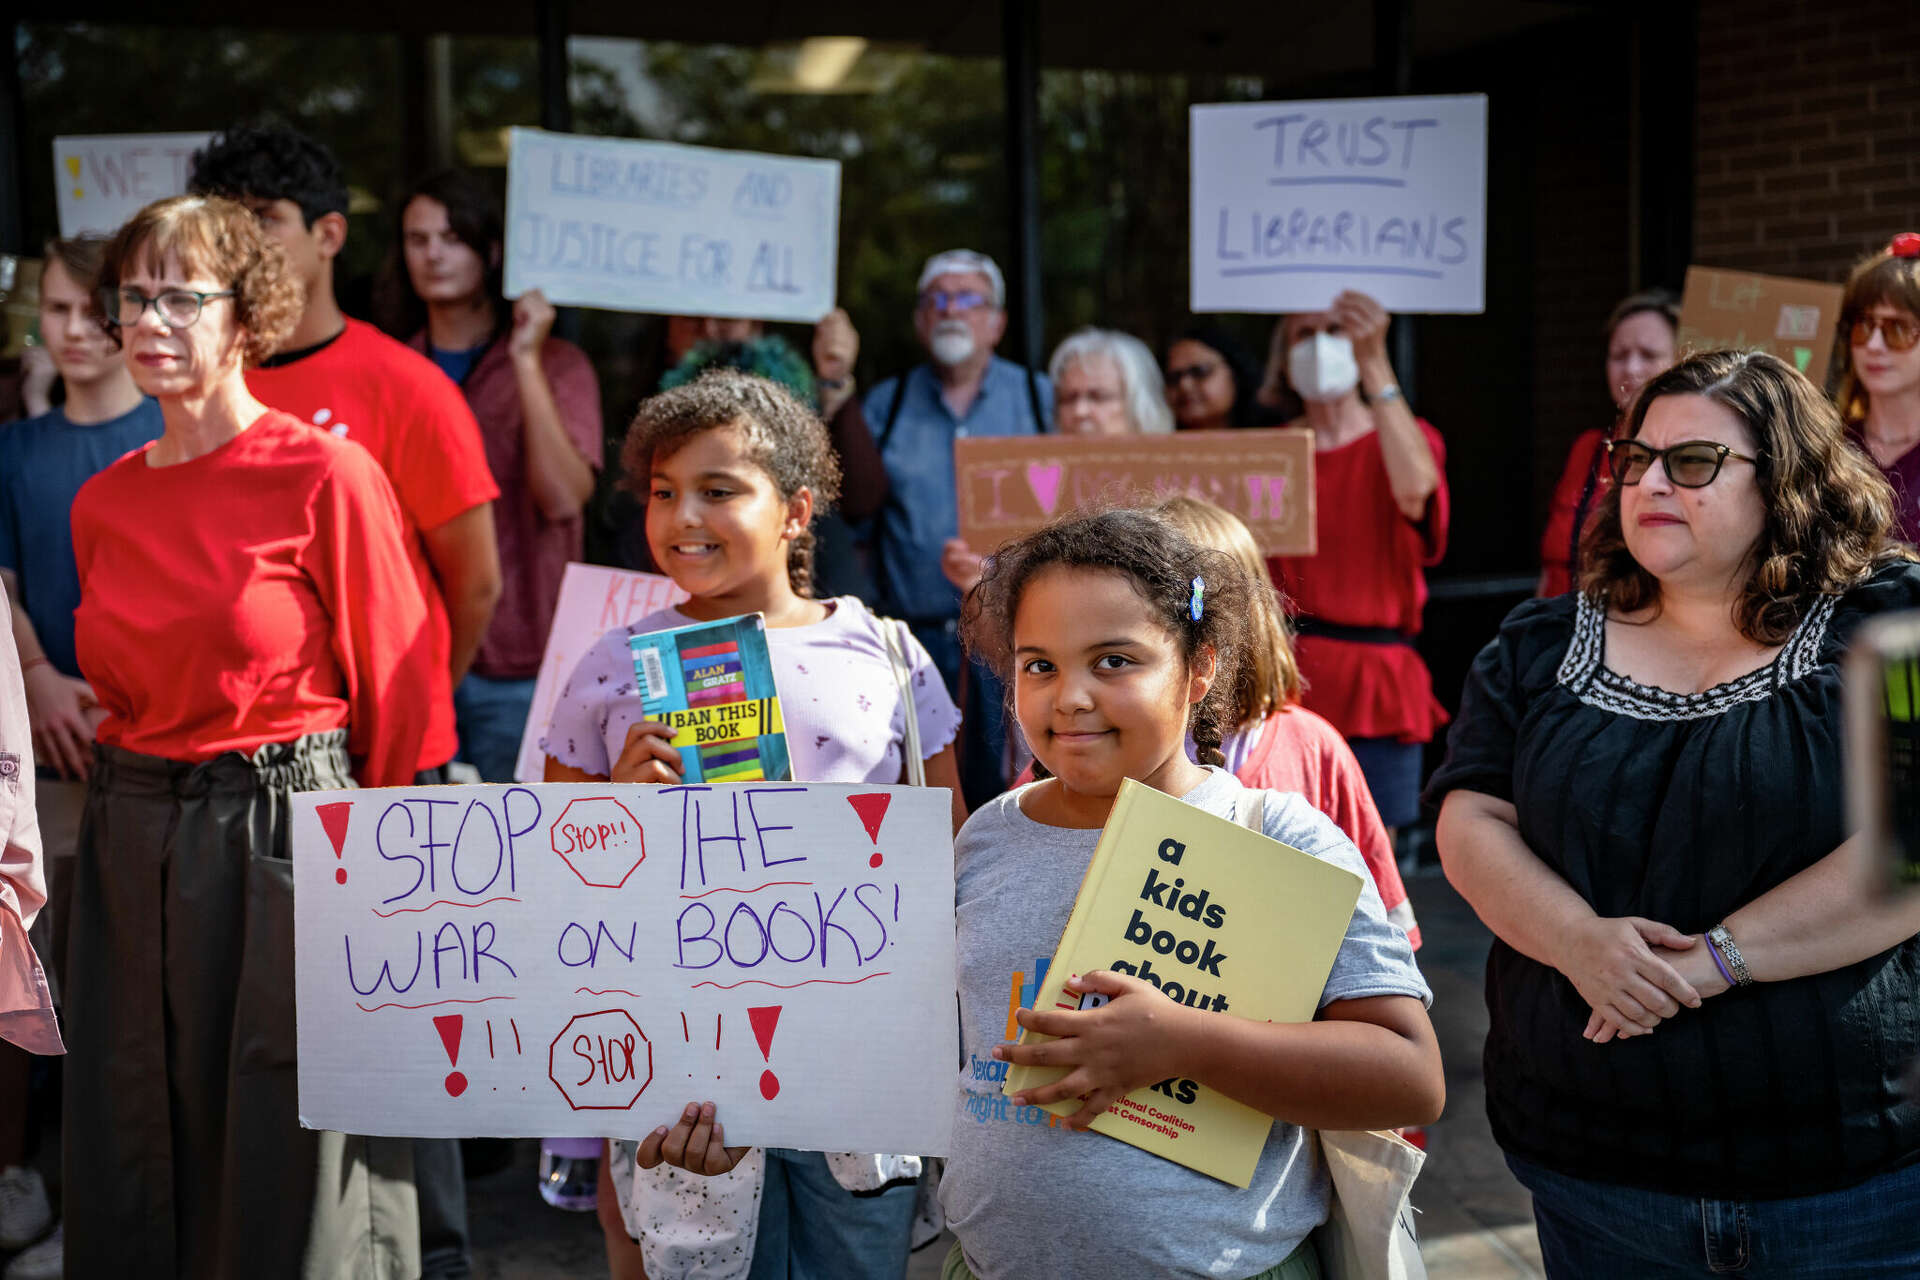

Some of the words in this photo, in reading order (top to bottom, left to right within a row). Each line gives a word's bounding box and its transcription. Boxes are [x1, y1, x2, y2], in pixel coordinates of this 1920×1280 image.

[1253, 113, 1440, 169] TRUST
[88, 147, 153, 198] WE
[549, 150, 710, 203] LIBRARIES
[732, 170, 793, 209] AND
[514, 212, 661, 278] JUSTICE
[678, 231, 734, 284] FOR
[749, 240, 801, 293] ALL
[1216, 207, 1470, 266] LIBRARIANS
[976, 469, 1012, 520] I
[693, 664, 726, 681] ALAN
[702, 672, 737, 688] GRATZ
[675, 710, 711, 728] BAN
[717, 703, 757, 722] THIS
[695, 722, 741, 743] BOOK
[376, 788, 542, 905] STOP
[657, 786, 808, 890] THE
[1157, 837, 1186, 866] a
[1139, 867, 1227, 929] kids
[344, 921, 518, 996] WAR
[557, 918, 636, 969] ON
[672, 883, 900, 969] BOOKS!
[1123, 909, 1228, 978] book
[1016, 1104, 1043, 1126] to
[1120, 1109, 1179, 1140] Censorship
[1147, 1107, 1196, 1133] Coalition
